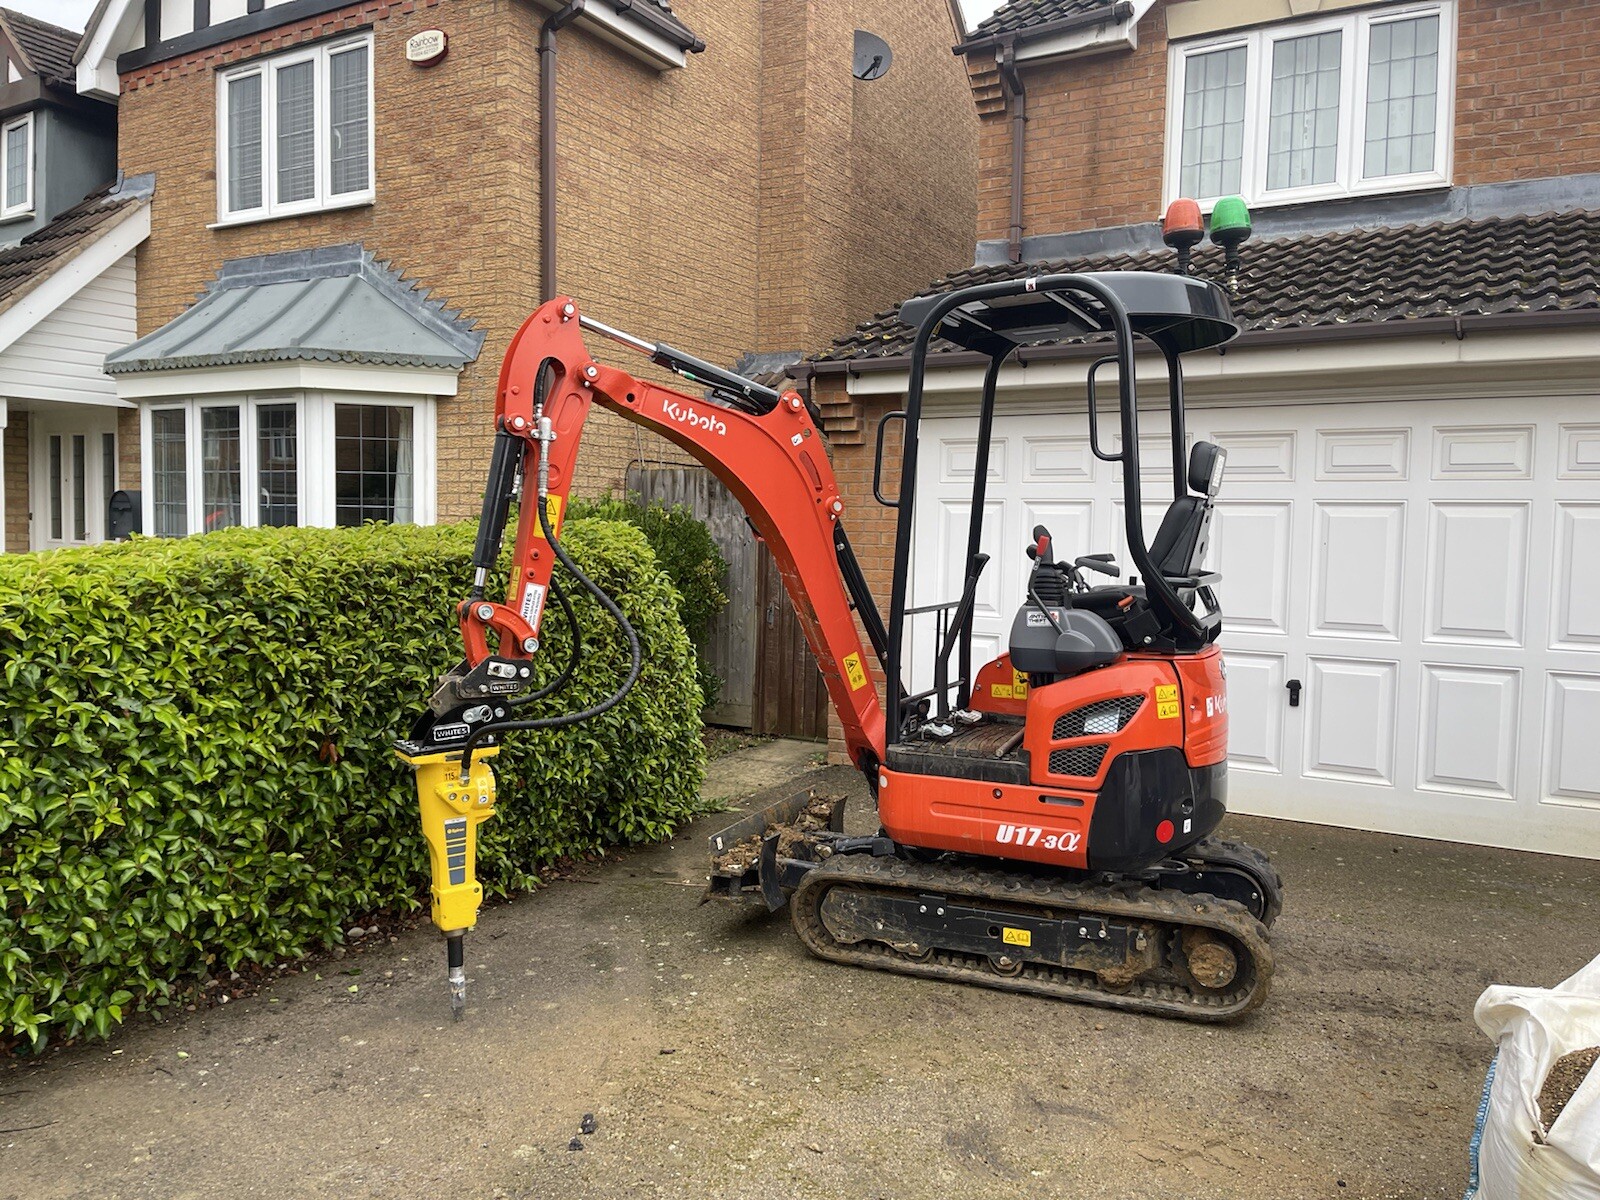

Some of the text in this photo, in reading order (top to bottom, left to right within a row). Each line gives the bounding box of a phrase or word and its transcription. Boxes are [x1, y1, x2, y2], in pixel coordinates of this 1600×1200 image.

[410, 36, 438, 48] Rainbow
[663, 399, 727, 435] Kubota
[492, 683, 517, 691] WHITES
[436, 727, 467, 738] WHITES
